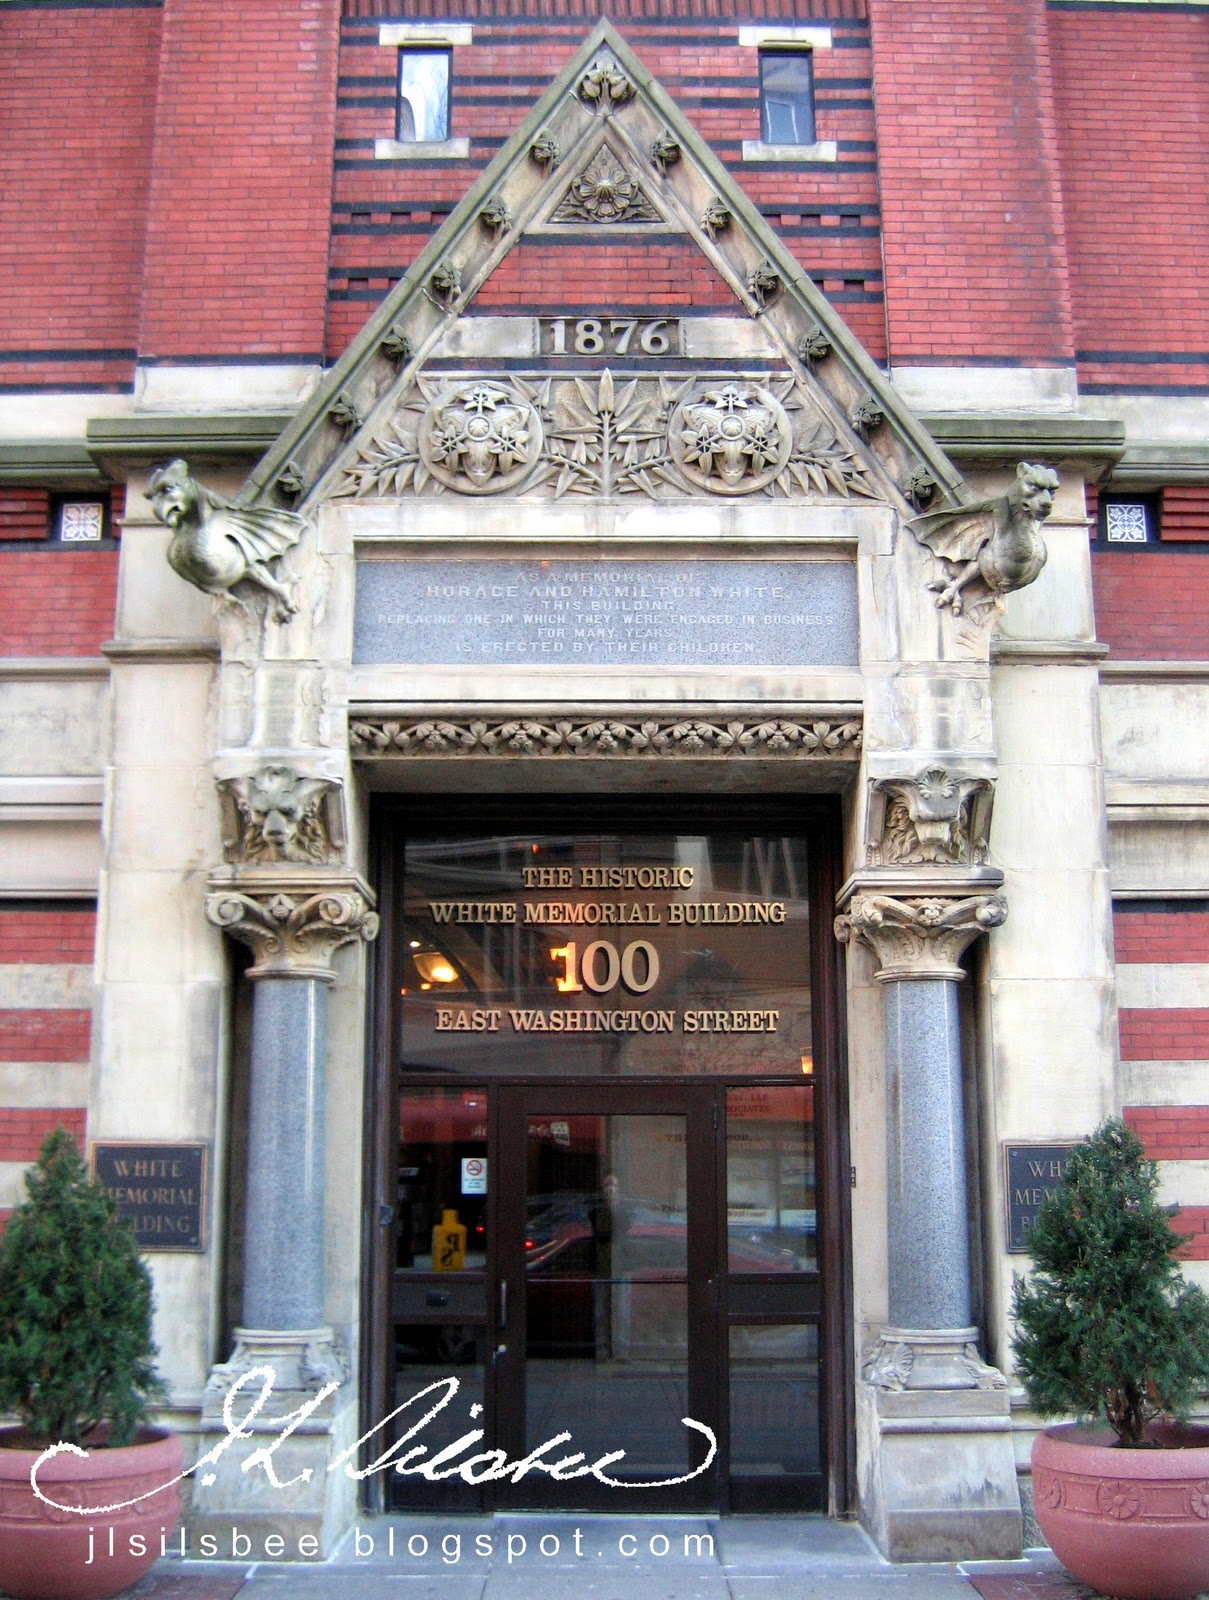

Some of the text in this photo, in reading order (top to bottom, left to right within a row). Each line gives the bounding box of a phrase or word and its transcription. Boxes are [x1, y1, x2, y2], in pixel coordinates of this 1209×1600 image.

[549, 319, 670, 355] 1876
[516, 572, 540, 582] AS
[546, 572, 559, 582] A
[564, 572, 669, 583] MEMORIAL
[426, 585, 519, 597] HORACE
[529, 585, 573, 597] AND
[582, 585, 702, 598] HAMILTON
[541, 600, 675, 611] THIS BUILDING
[377, 613, 834, 626] REPLACING ONE IN WHICH THEY WERE ENGAGED IN BUSINESS
[537, 628, 566, 638] FOR
[574, 628, 616, 638] MANY
[456, 642, 473, 652] IS
[481, 642, 564, 652] ERECTED
[605, 642, 659, 652] THEIR
[522, 867, 694, 888] THE HISTORIC
[429, 902, 787, 924] WHITE MEMORIAL BUILDING
[549, 939, 660, 993] 100
[435, 1009, 780, 1031] EAST WASHINGTON STREET
[113, 1160, 183, 1177] WHITE
